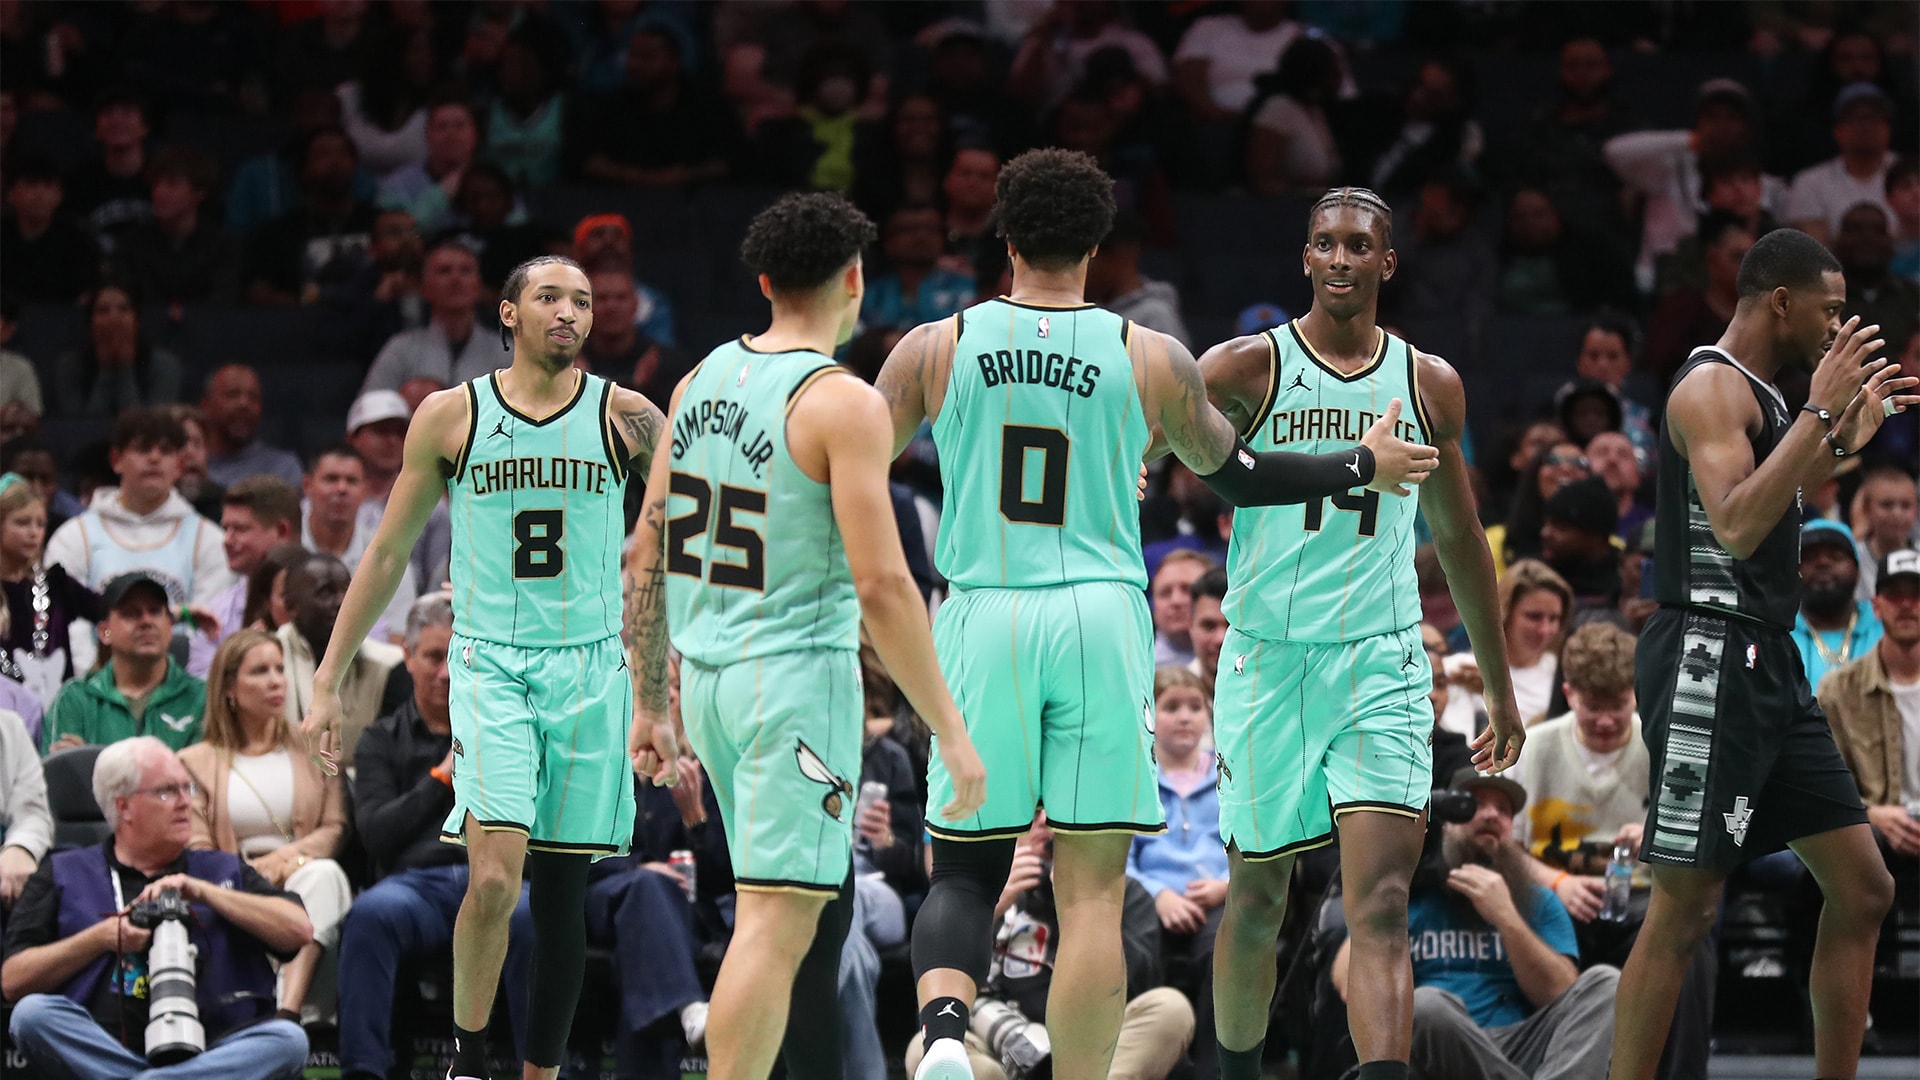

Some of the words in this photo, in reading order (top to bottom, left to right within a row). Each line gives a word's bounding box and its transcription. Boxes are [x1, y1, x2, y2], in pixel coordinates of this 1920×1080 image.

[977, 349, 1101, 398] BRIDGES
[671, 399, 749, 460] SIMPSON
[741, 430, 774, 480] JR.
[1272, 407, 1416, 445] CHARLOTE
[470, 457, 608, 495] CHARLOTTE
[998, 423, 1071, 528] 0
[513, 508, 567, 580] 8
[665, 470, 769, 595] 25
[1409, 930, 1503, 962] HORNET
